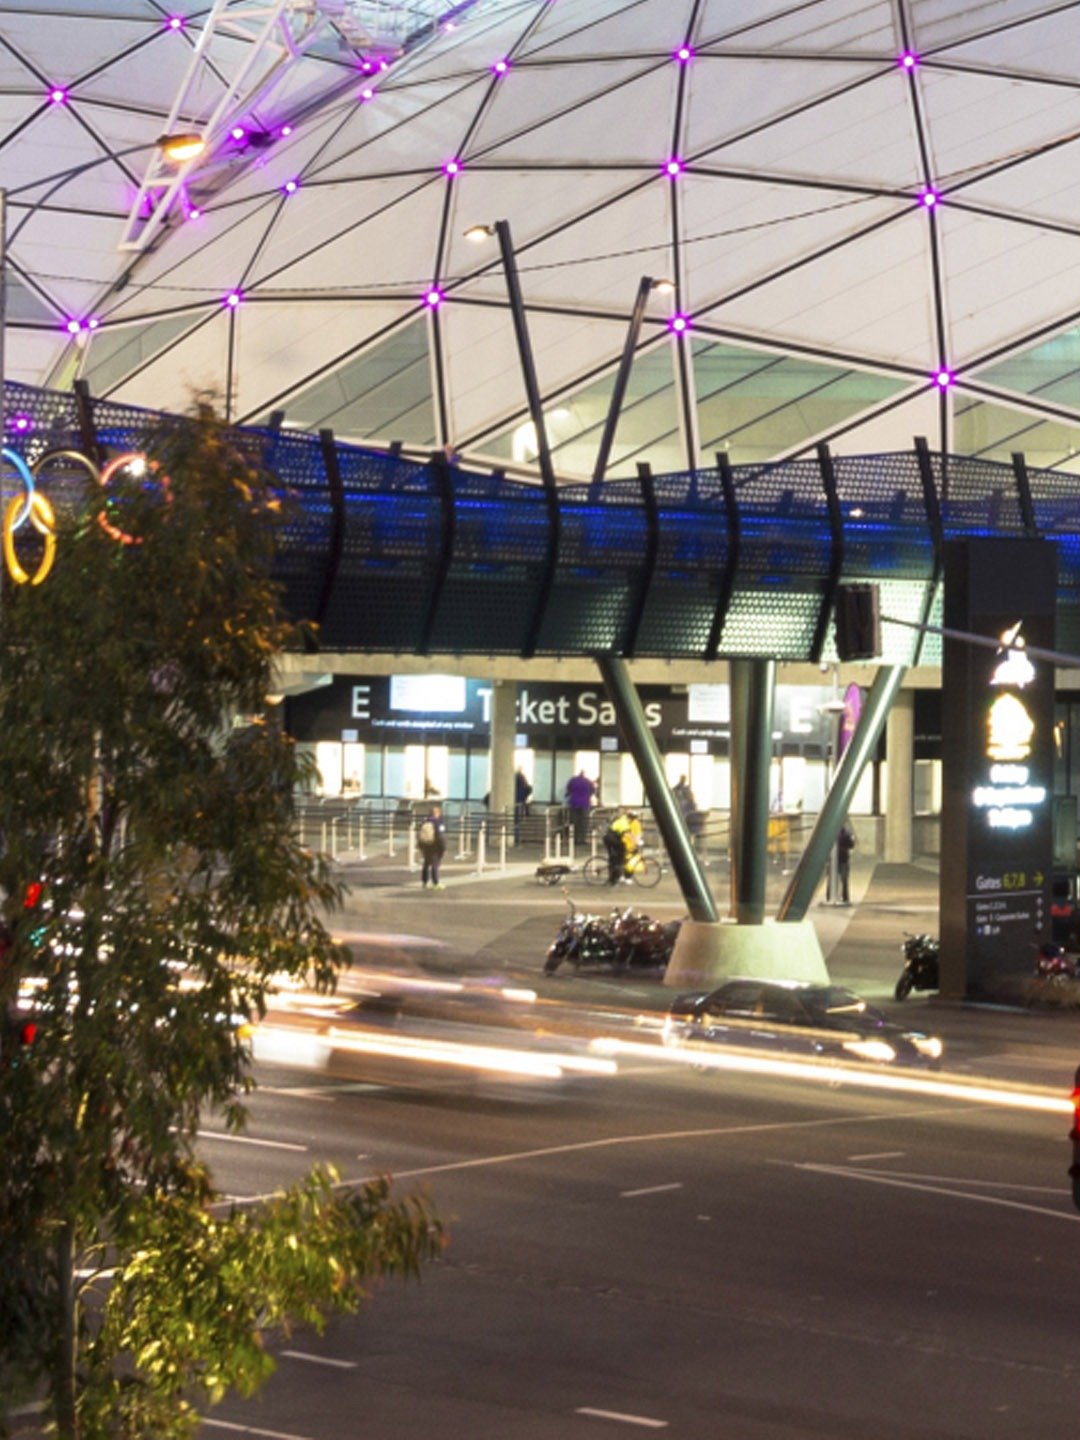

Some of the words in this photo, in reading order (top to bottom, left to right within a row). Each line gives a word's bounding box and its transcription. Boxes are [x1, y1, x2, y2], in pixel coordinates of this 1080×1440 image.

[352, 686, 370, 719] E
[477, 687, 570, 726] Tket
[577, 691, 663, 727] Sas
[790, 696, 813, 733] E
